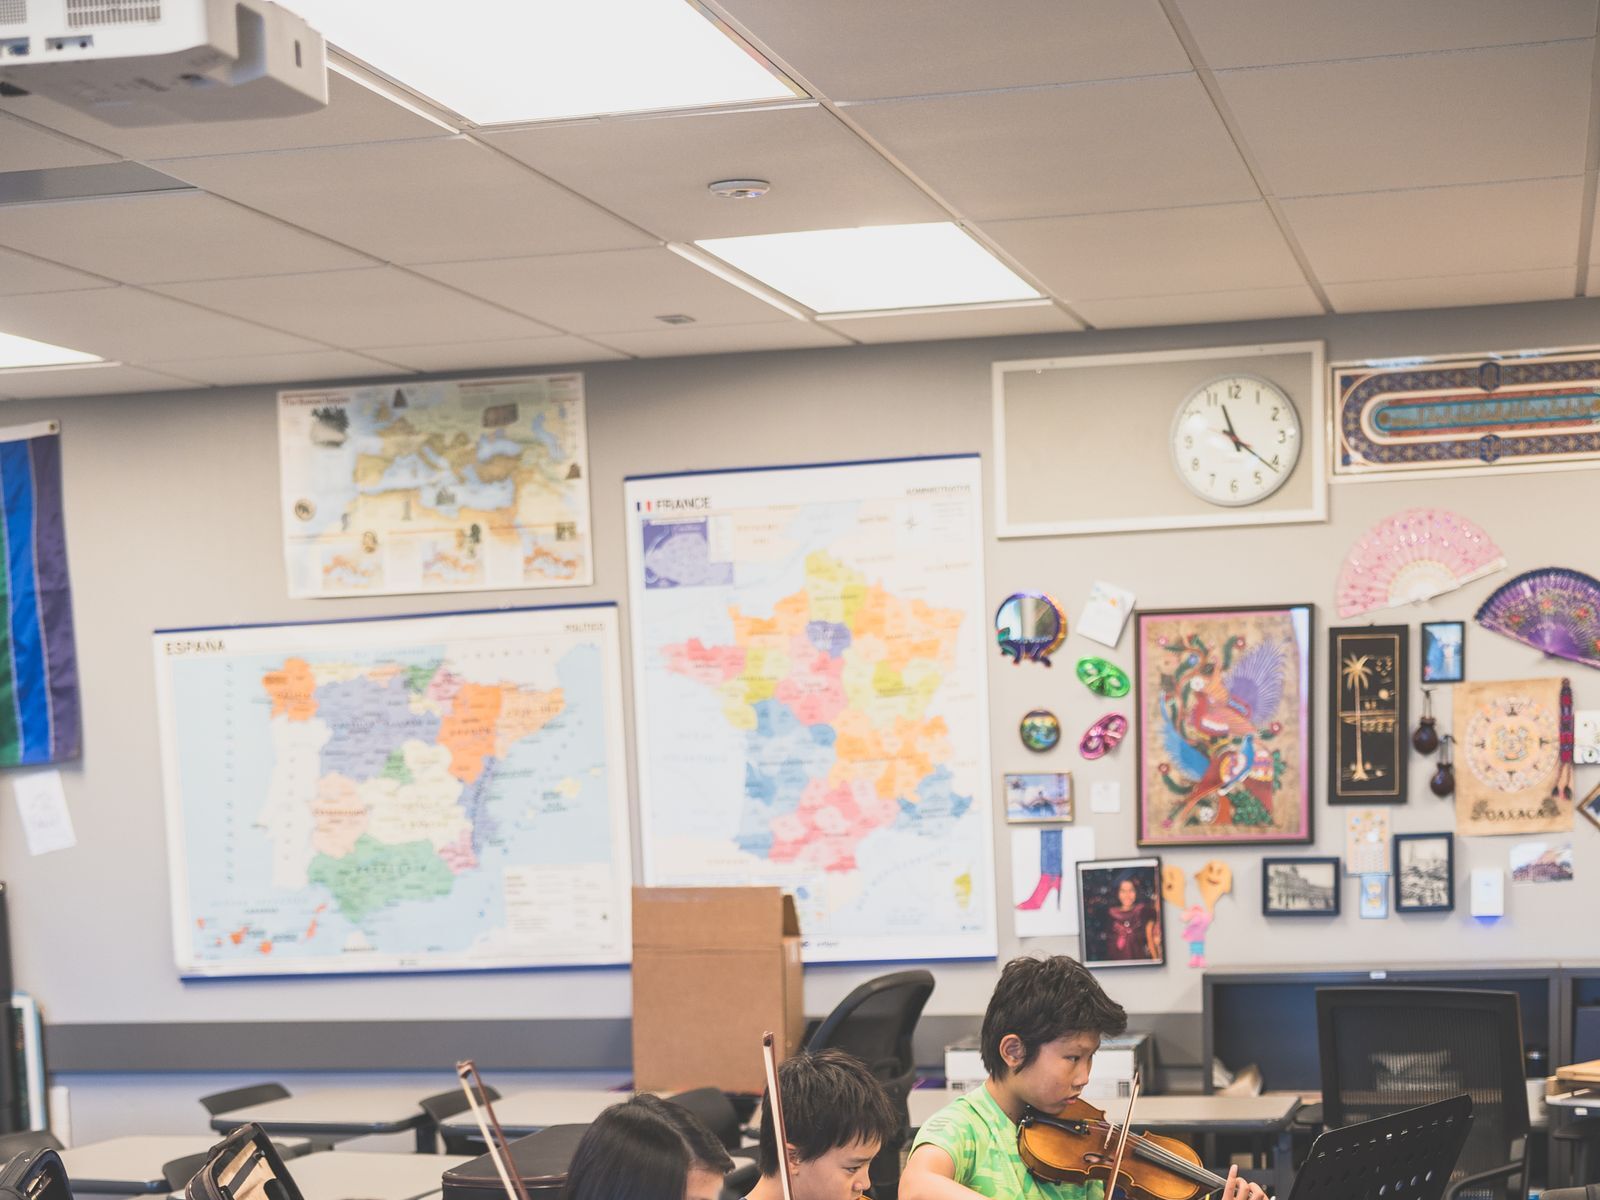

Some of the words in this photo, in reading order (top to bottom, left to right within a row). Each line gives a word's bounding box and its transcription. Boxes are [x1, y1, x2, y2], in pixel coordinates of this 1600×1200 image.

[1228, 384, 1241, 399] 12
[1207, 392, 1218, 407] 11
[1271, 407, 1280, 421] 2
[1278, 430, 1287, 444] 3
[1271, 454, 1280, 466] 4
[1253, 471, 1262, 485] 5
[1229, 479, 1239, 493] 6
[656, 497, 710, 510] FRANCE
[1485, 808, 1545, 822] OAXACA
